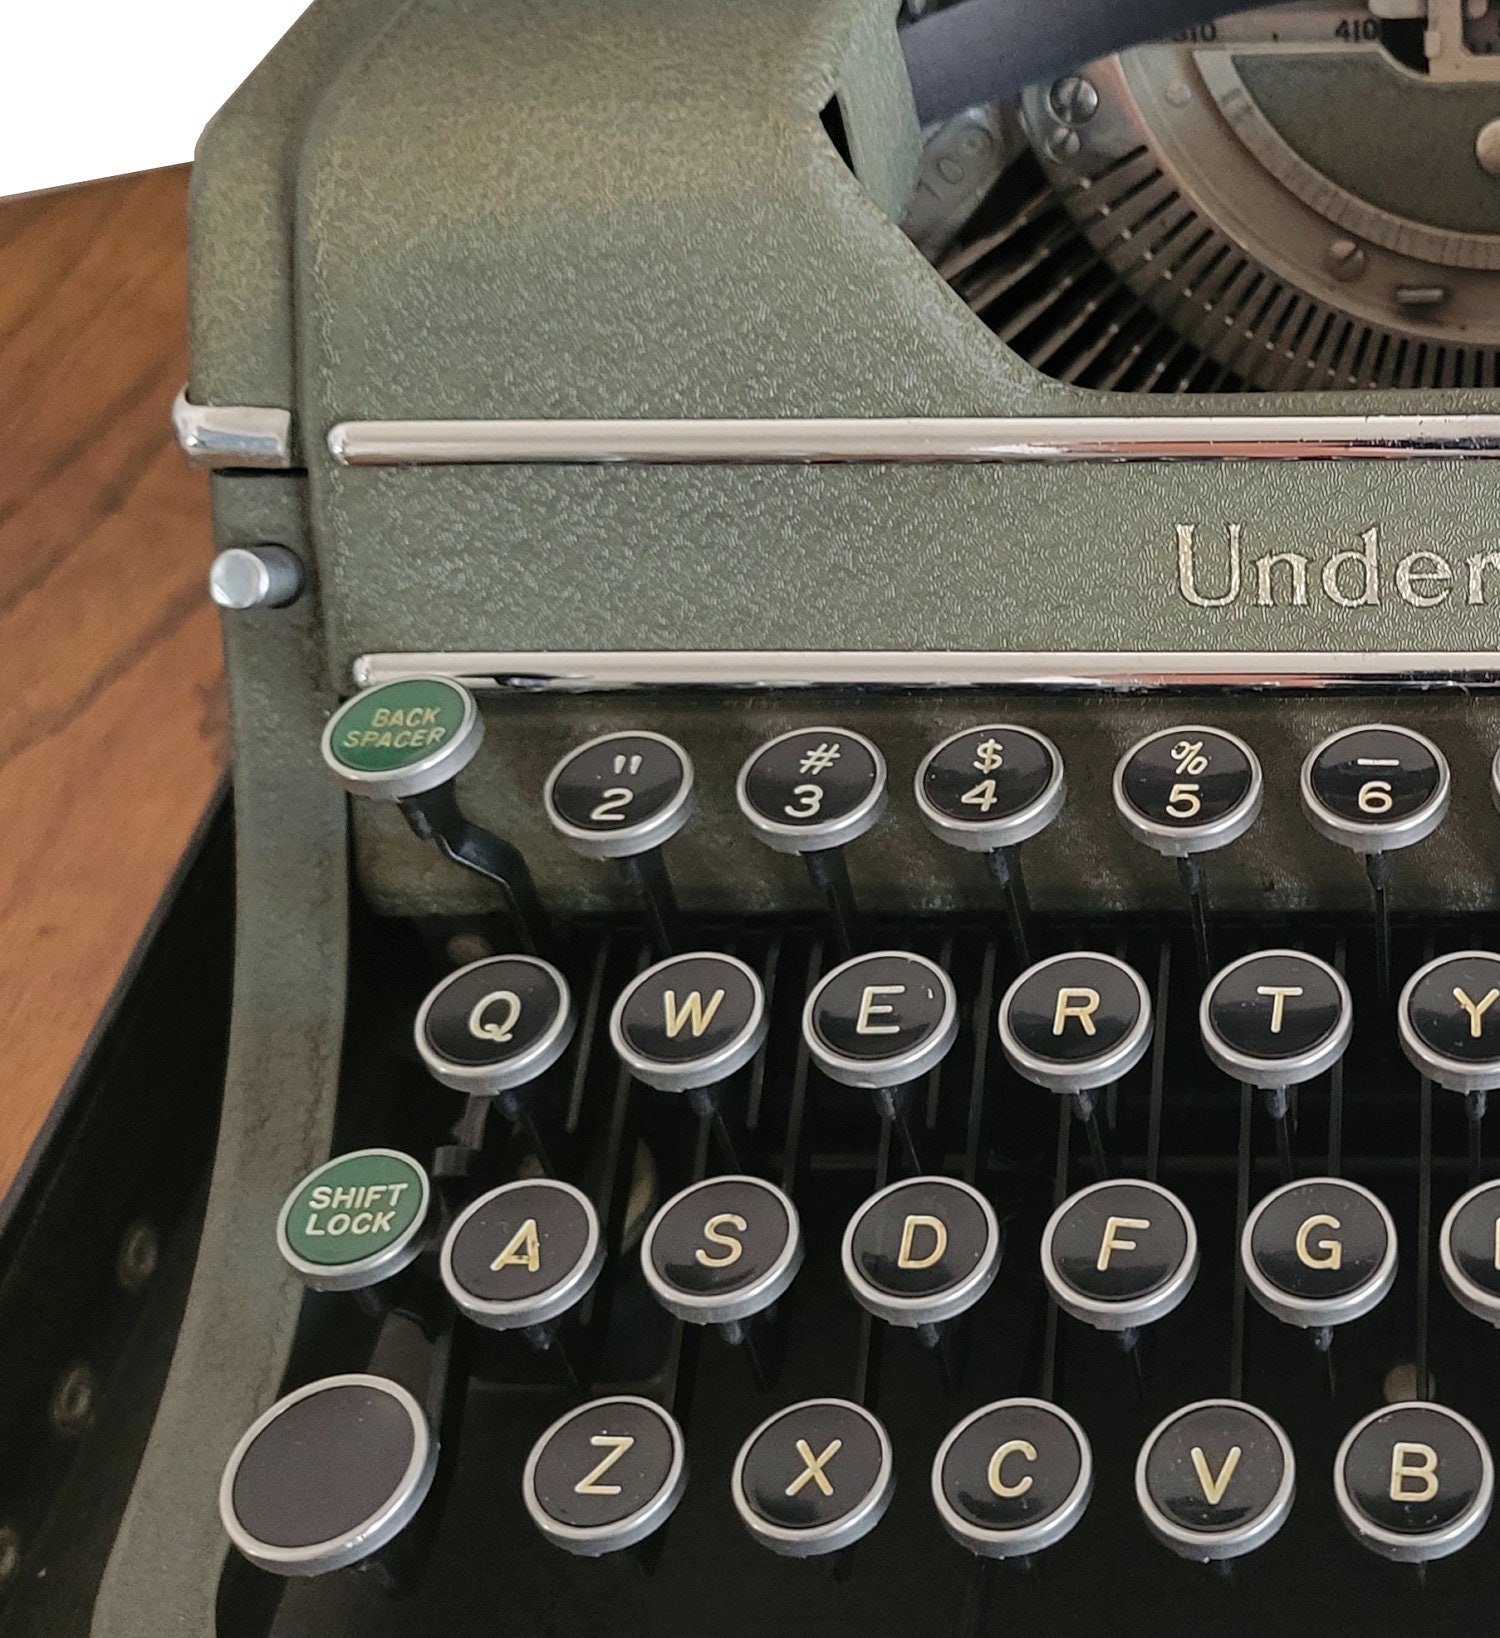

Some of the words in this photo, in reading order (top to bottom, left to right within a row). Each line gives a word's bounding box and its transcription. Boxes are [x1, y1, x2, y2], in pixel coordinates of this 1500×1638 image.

[1172, 21, 1217, 43] 10
[1334, 18, 1381, 43] 410
[343, 725, 447, 750] SPACER
[371, 706, 442, 728] BACK
[799, 743, 841, 775] #
[972, 738, 1003, 774] $
[1170, 740, 1208, 775] %
[590, 787, 634, 821] 2
[784, 783, 824, 818] 3
[960, 779, 998, 812] 4
[1165, 783, 1201, 818] 5
[1358, 780, 1393, 814] 6
[468, 990, 521, 1043] Q
[663, 989, 725, 1038] W
[855, 985, 906, 1034] E
[1052, 987, 1100, 1036] R
[1256, 985, 1304, 1033] T
[1452, 986, 1500, 1038] Y
[308, 1181, 409, 1211] SHIFT
[304, 1209, 397, 1236] LOCK
[489, 1218, 540, 1272] A
[695, 1213, 747, 1267] S
[897, 1214, 947, 1269] D
[1096, 1216, 1150, 1271] F
[1295, 1214, 1342, 1270] G
[574, 1435, 634, 1495] Z
[784, 1439, 842, 1496] X
[987, 1439, 1037, 1497] C
[1190, 1446, 1242, 1505] V
[1389, 1442, 1439, 1502] B
